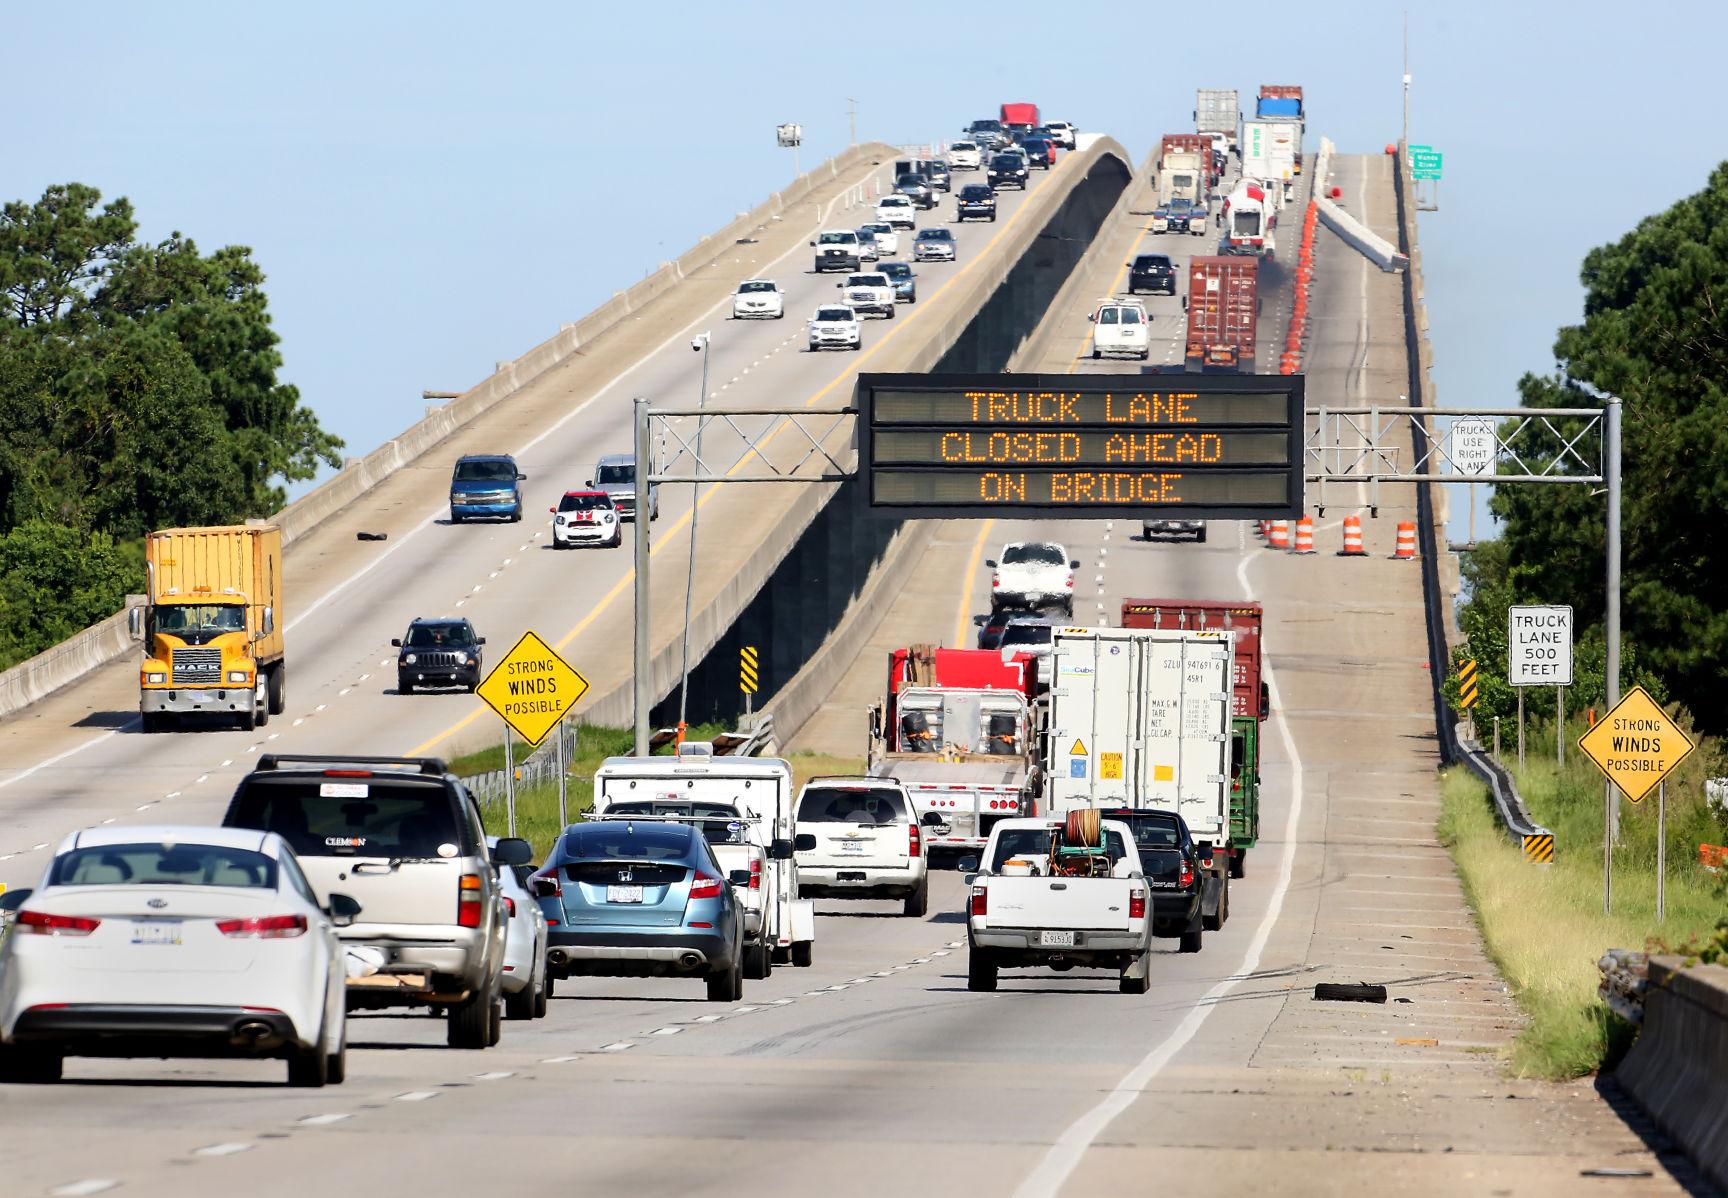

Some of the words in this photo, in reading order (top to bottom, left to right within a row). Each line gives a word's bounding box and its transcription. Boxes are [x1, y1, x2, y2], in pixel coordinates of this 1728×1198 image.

[964, 392, 1080, 422] TRUCK
[1105, 393, 1198, 423] LANE
[941, 432, 1080, 462] CLOSED
[1105, 433, 1222, 463] AHEAD
[1463, 438, 1484, 447] USE
[1458, 449, 1487, 459] RIGHT
[1460, 461, 1486, 471] LANE
[980, 473, 1025, 502] ON
[1051, 473, 1183, 502] BRIDGE
[1515, 615, 1567, 628] TRUCK
[1519, 632, 1562, 644] LANE
[1525, 648, 1557, 660] 500
[508, 659, 554, 675] STRONG
[1521, 663, 1560, 675] FEET
[508, 677, 557, 696] WINDS
[505, 699, 563, 715] POSSIBLE
[1151, 709, 1166, 718] TARE
[1150, 719, 1162, 728] NET
[1613, 718, 1660, 732] STRONG
[1612, 736, 1661, 753] WINDS
[1100, 752, 1123, 761] CAUTION
[1607, 758, 1665, 772] POSSIBLE
